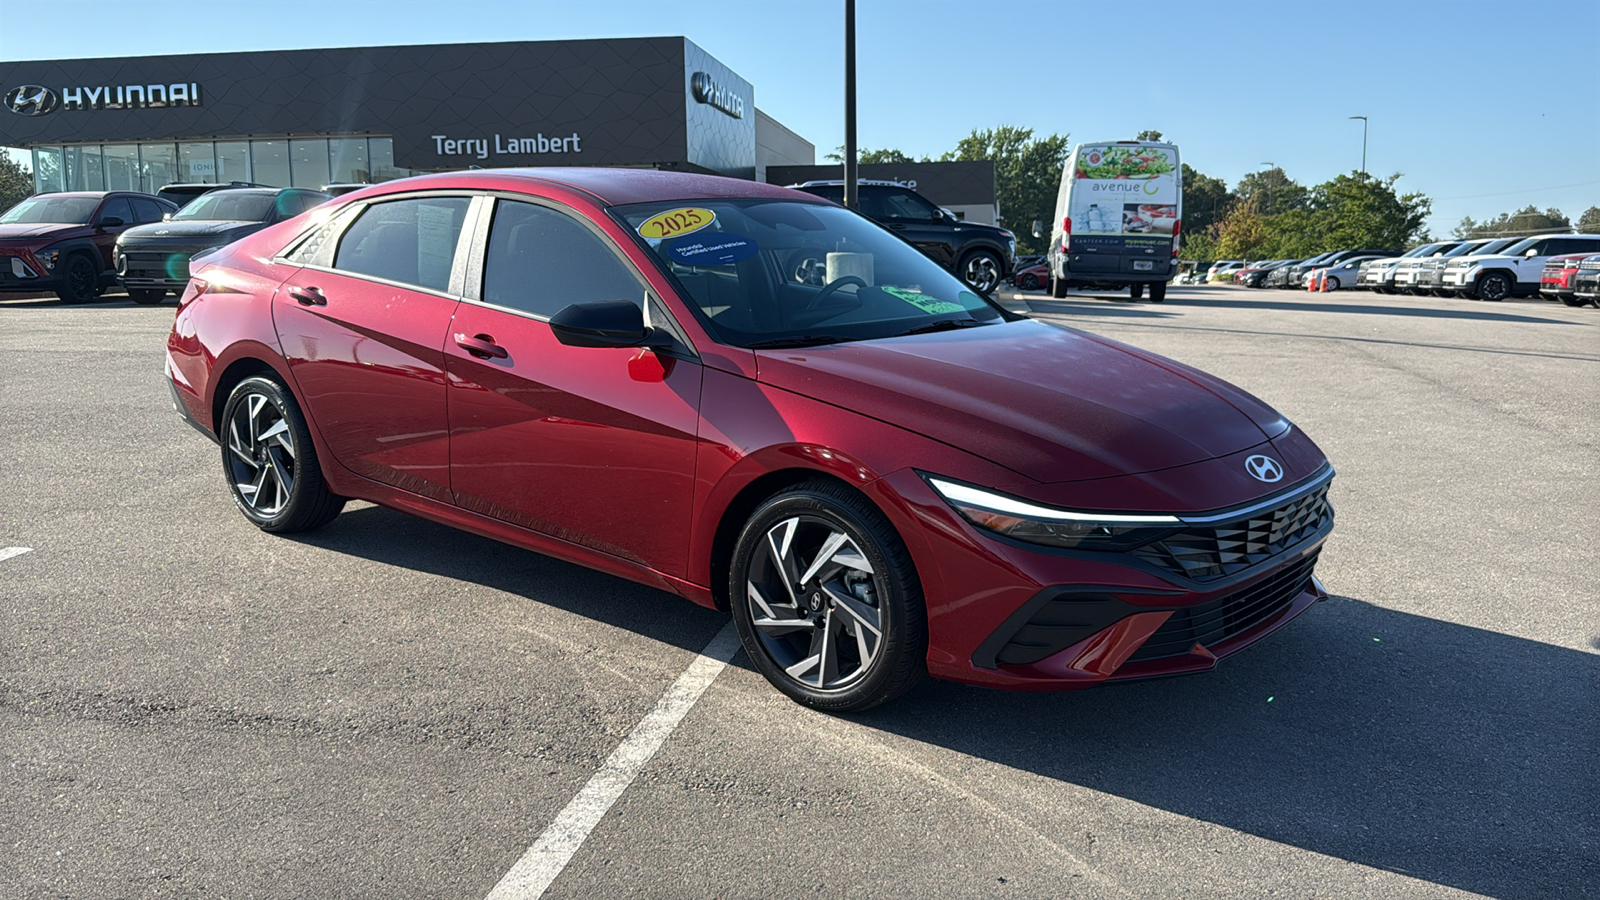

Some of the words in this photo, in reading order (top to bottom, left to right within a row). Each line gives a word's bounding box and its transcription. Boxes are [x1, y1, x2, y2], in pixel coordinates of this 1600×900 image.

[62, 83, 198, 110] HYUNDAI
[431, 135, 488, 159] Terry
[495, 133, 581, 153] Lambert
[1092, 183, 1140, 192] avenue
[652, 209, 702, 236] 2025
[675, 243, 703, 252] Hyundai
[681, 247, 708, 257] Certified
[723, 241, 747, 249] Vehicles
